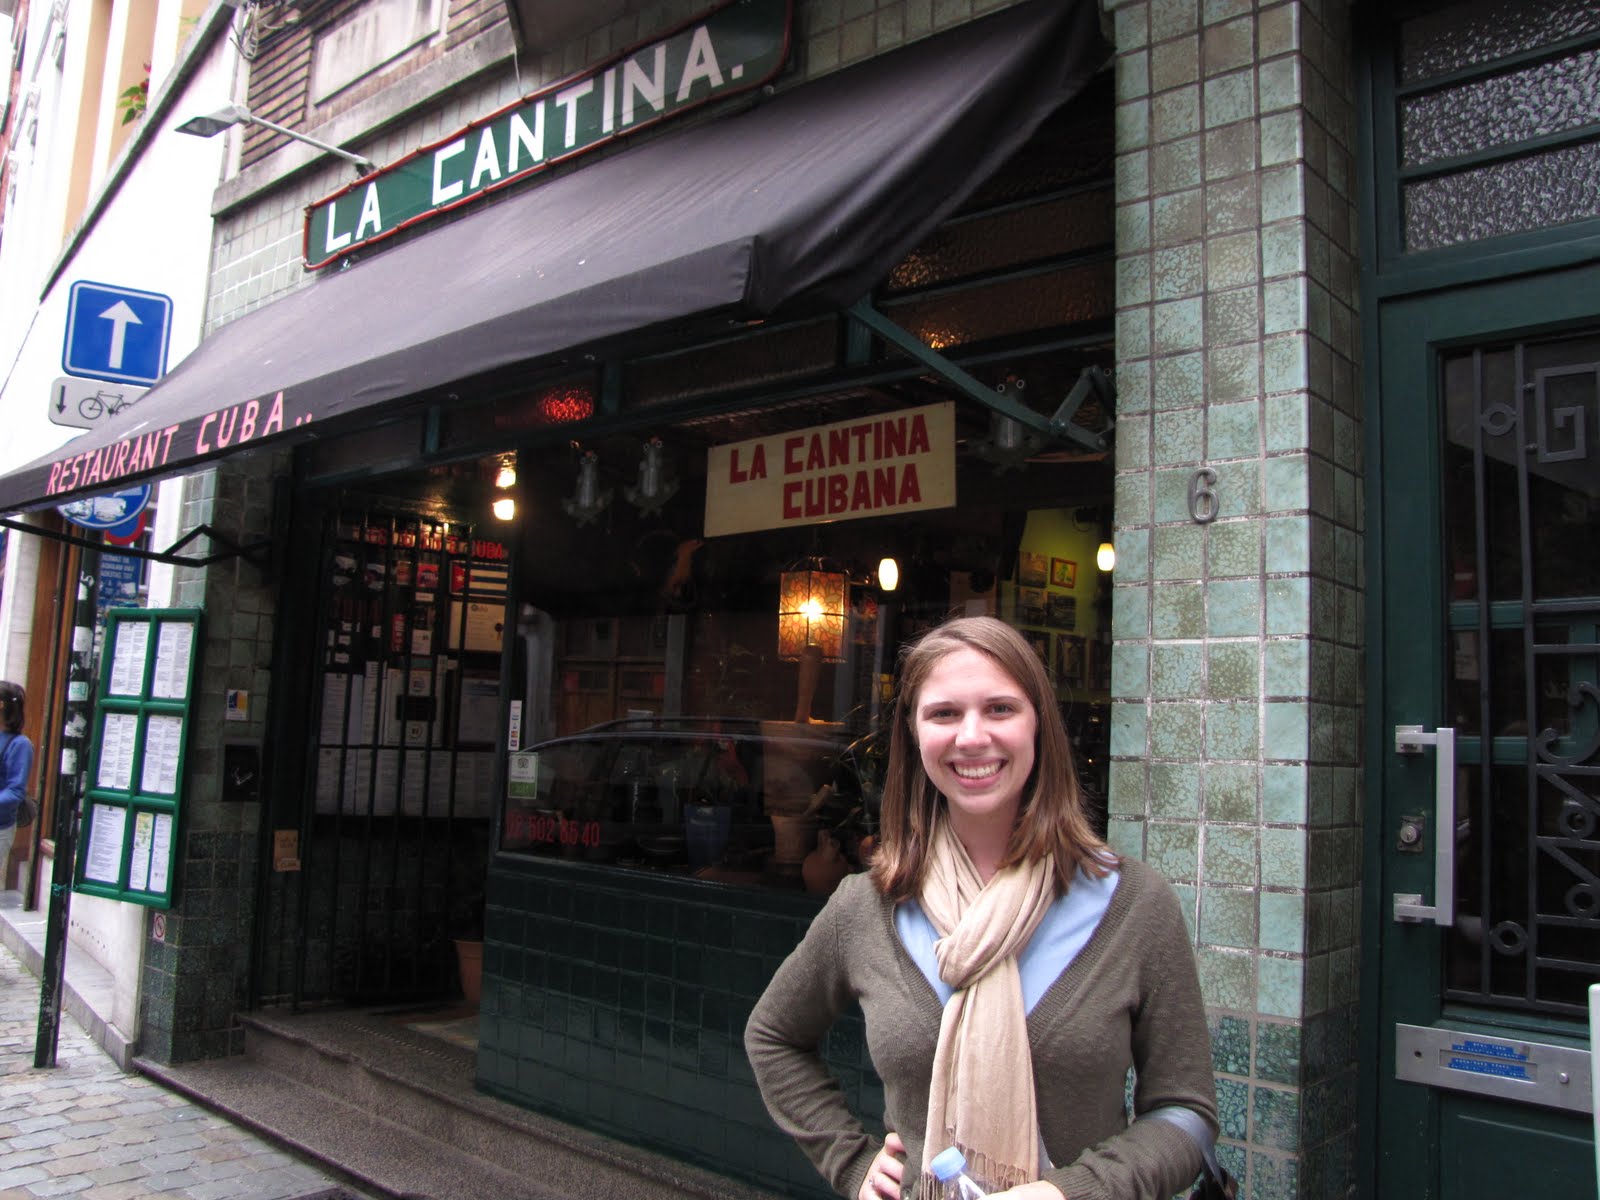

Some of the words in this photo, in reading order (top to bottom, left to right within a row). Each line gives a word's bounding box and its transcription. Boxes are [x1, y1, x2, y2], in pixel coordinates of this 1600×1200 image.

[326, 182, 381, 253] LA
[46, 424, 180, 496] RESTAURANT
[729, 443, 767, 484] LA
[784, 414, 931, 475] CANTINA
[783, 463, 922, 520] CUBANA
[1187, 466, 1220, 523] 6
[582, 820, 601, 848] 40
